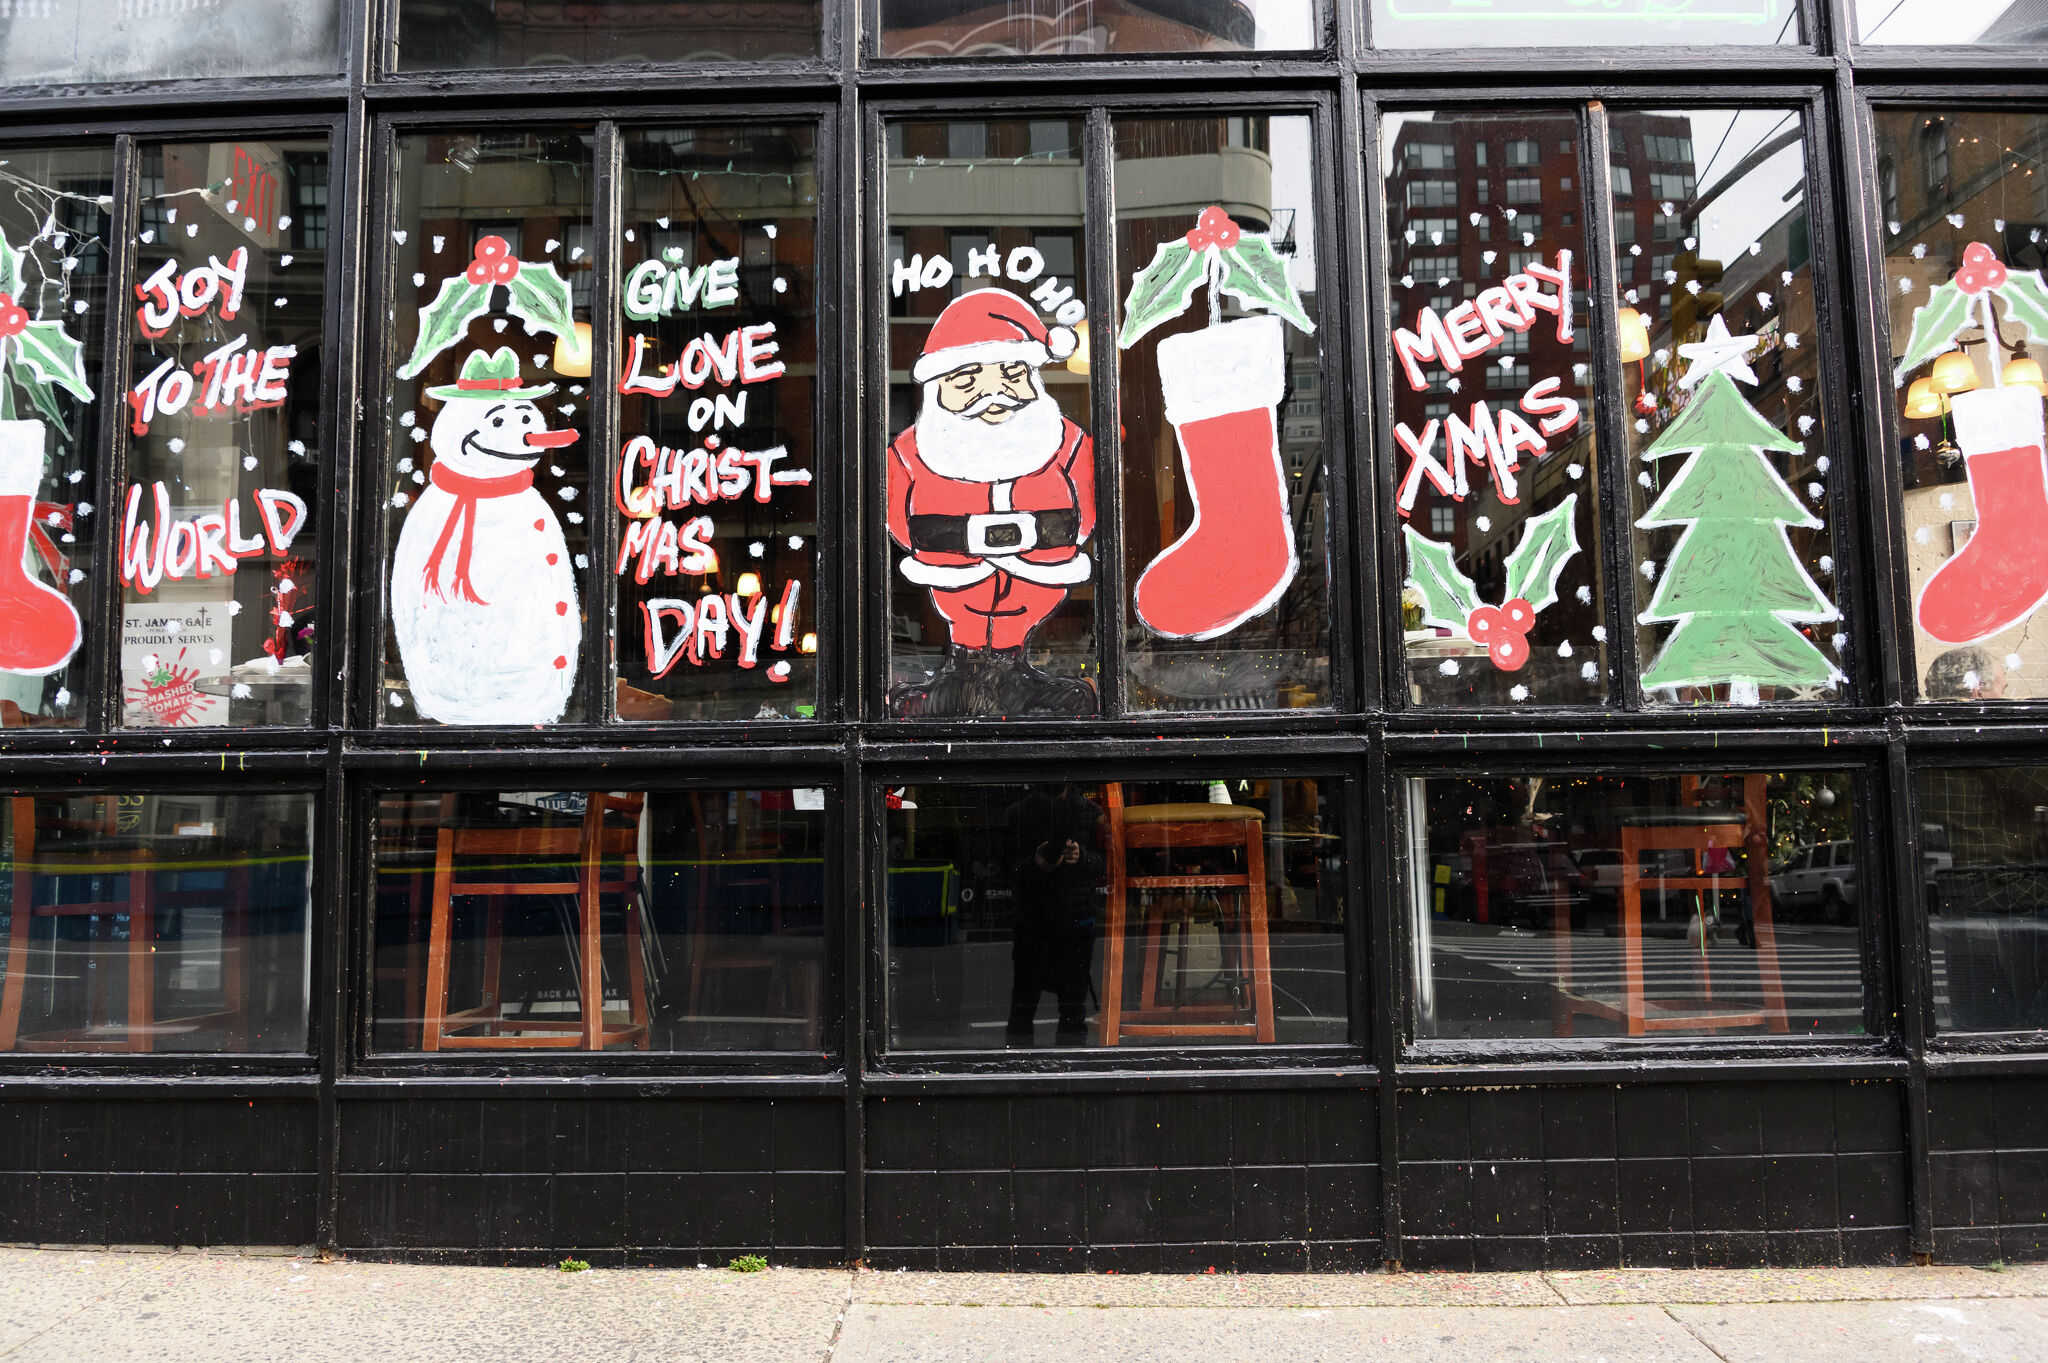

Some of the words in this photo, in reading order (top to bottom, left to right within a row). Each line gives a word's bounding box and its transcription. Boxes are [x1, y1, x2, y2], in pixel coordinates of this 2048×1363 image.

[137, 245, 249, 339] JOY
[624, 246, 739, 322] GIVE
[892, 253, 953, 297] HO
[968, 243, 1045, 283] HO
[1030, 276, 1086, 325] HO
[1392, 248, 1575, 391] MERRY
[129, 356, 194, 436] TO
[192, 334, 297, 417] THE
[618, 322, 786, 398] LOVE
[688, 391, 747, 432] ON
[1394, 376, 1580, 518] XMAS
[119, 481, 308, 595] WORLD
[615, 516, 716, 585] MAS
[124, 636, 174, 645] PROUDLY
[178, 634, 214, 644] SERVES
[125, 619, 142, 628] ST.
[145, 618, 183, 628] JAMS
[638, 579, 801, 683] DAY!
[141, 682, 194, 707] SMASHED
[149, 694, 195, 712] TOMATO
[537, 799, 567, 810] BLUE
